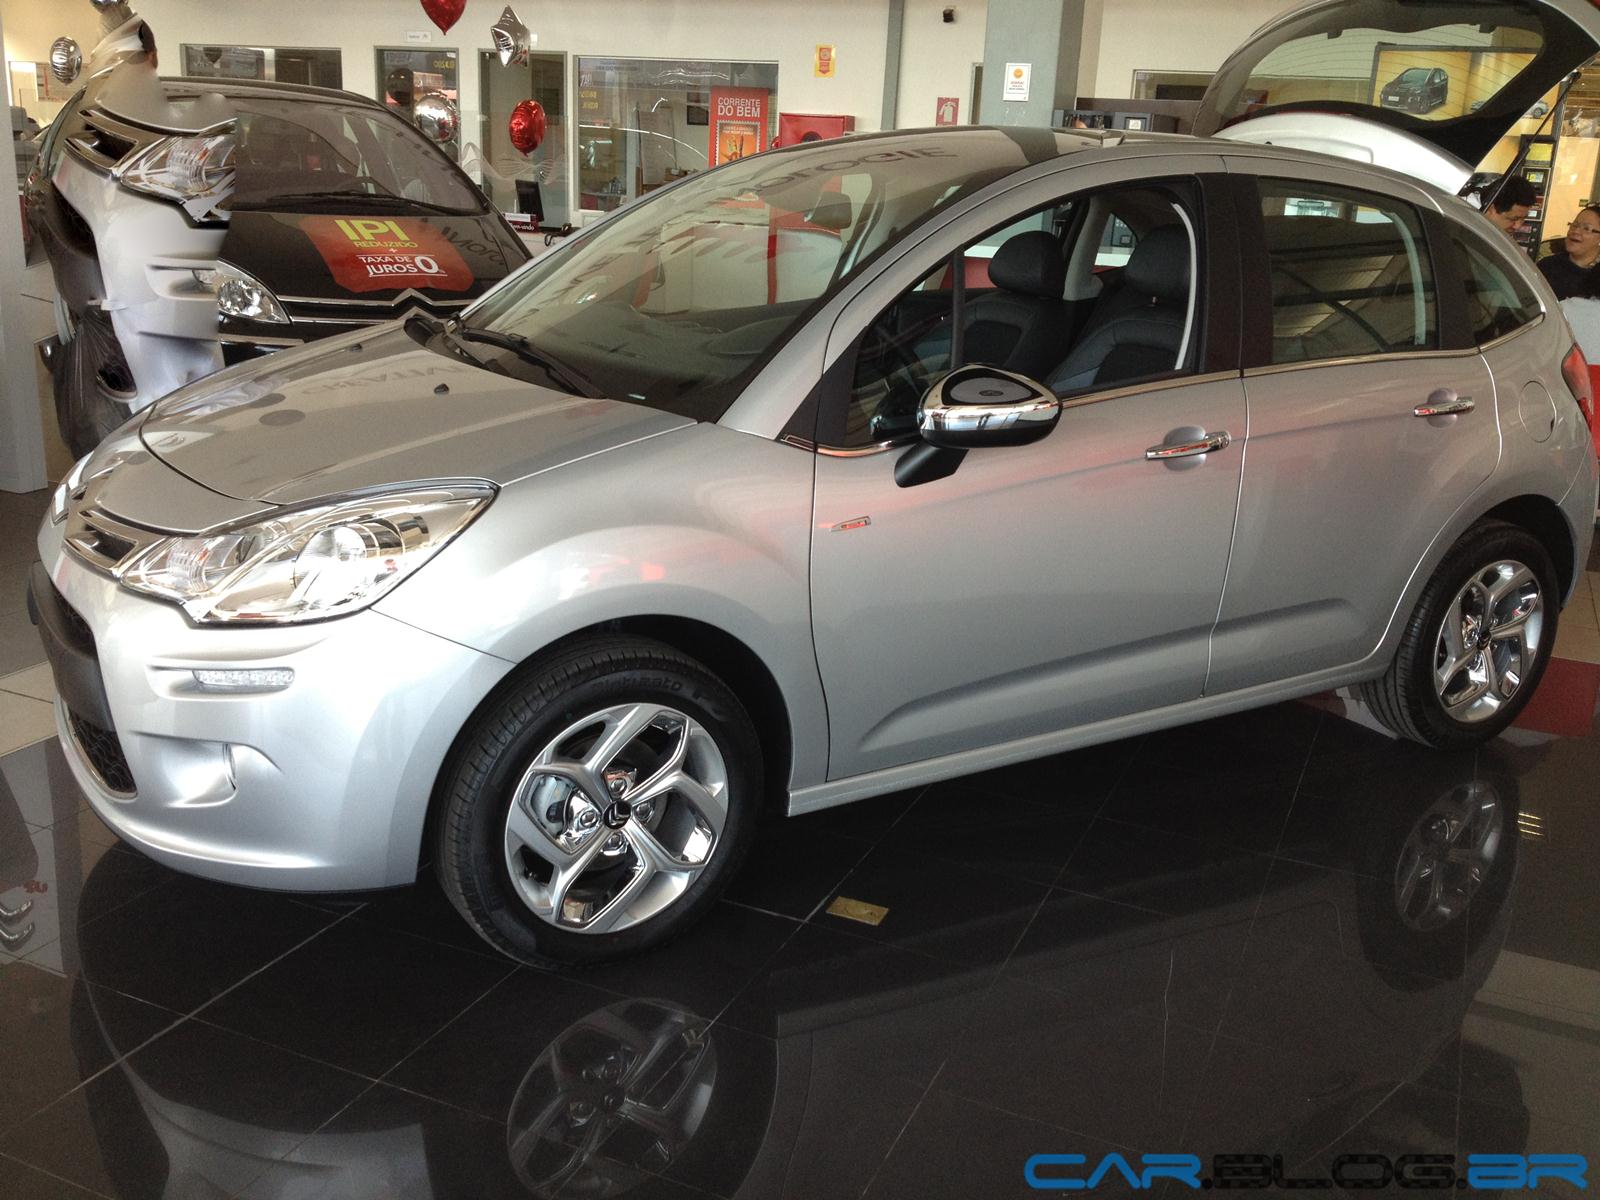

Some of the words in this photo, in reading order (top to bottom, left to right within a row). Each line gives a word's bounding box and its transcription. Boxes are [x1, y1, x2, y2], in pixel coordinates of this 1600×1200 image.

[718, 97, 760, 107] CORRENTE
[718, 106, 733, 116] DO
[737, 106, 760, 118] BEM
[335, 219, 410, 241] IPI
[353, 241, 418, 249] REDUZIDO
[359, 256, 394, 264] TAXA
[396, 255, 413, 263] DE
[368, 264, 418, 274] JUROS
